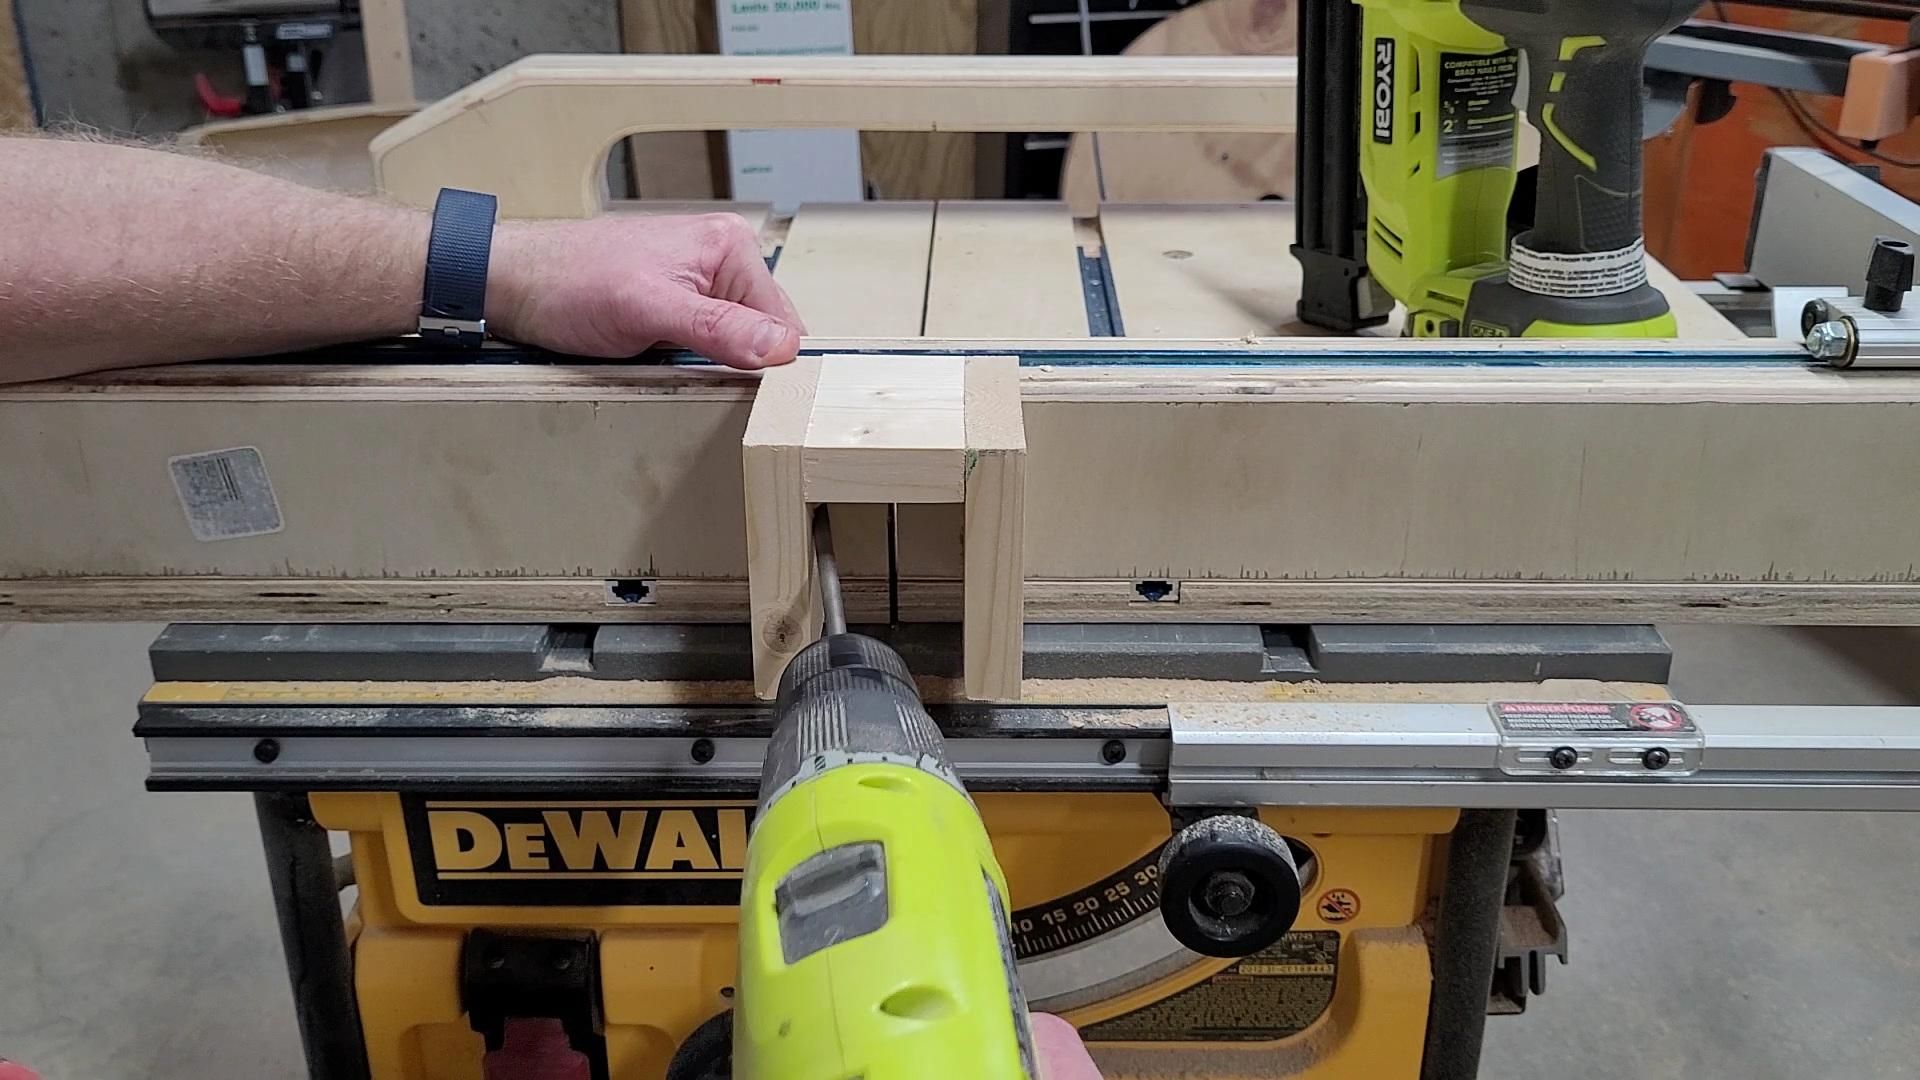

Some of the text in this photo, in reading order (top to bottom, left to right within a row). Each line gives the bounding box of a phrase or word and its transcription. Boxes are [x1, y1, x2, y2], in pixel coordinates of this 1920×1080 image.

[1376, 43, 1392, 137] RYOBI
[427, 809, 749, 870] DEWAL
[1012, 864, 1158, 934] 10 15 20 25 30
